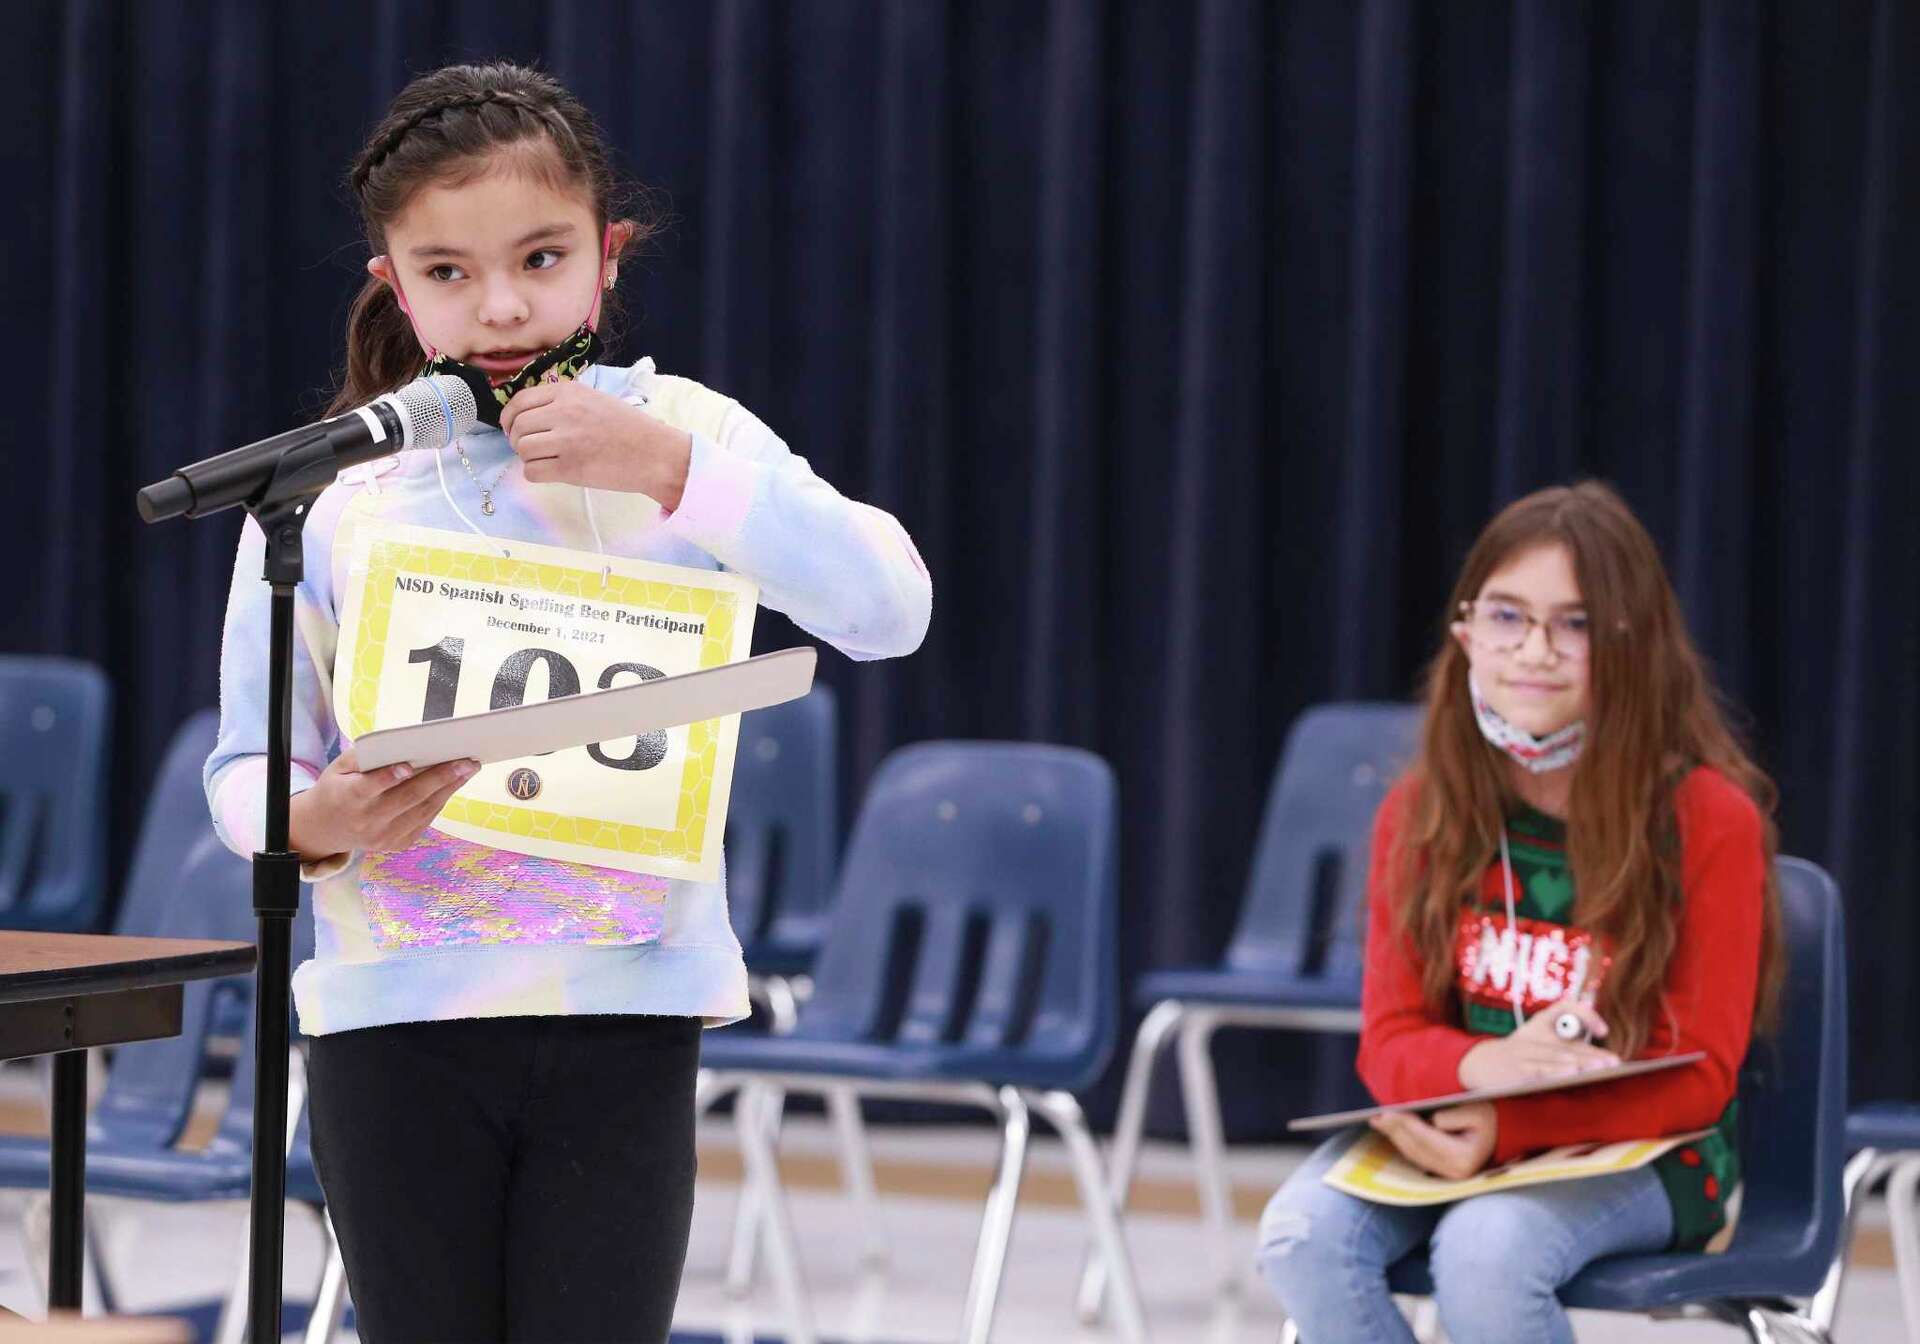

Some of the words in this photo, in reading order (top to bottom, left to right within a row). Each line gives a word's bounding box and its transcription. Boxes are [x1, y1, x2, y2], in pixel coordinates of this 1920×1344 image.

[394, 576, 434, 594] NISD
[439, 582, 504, 605] Spanish
[509, 592, 576, 618] Spelling
[580, 603, 610, 622] Bee
[615, 609, 706, 636] Participant
[486, 615, 551, 636] December
[571, 628, 606, 644] 2021
